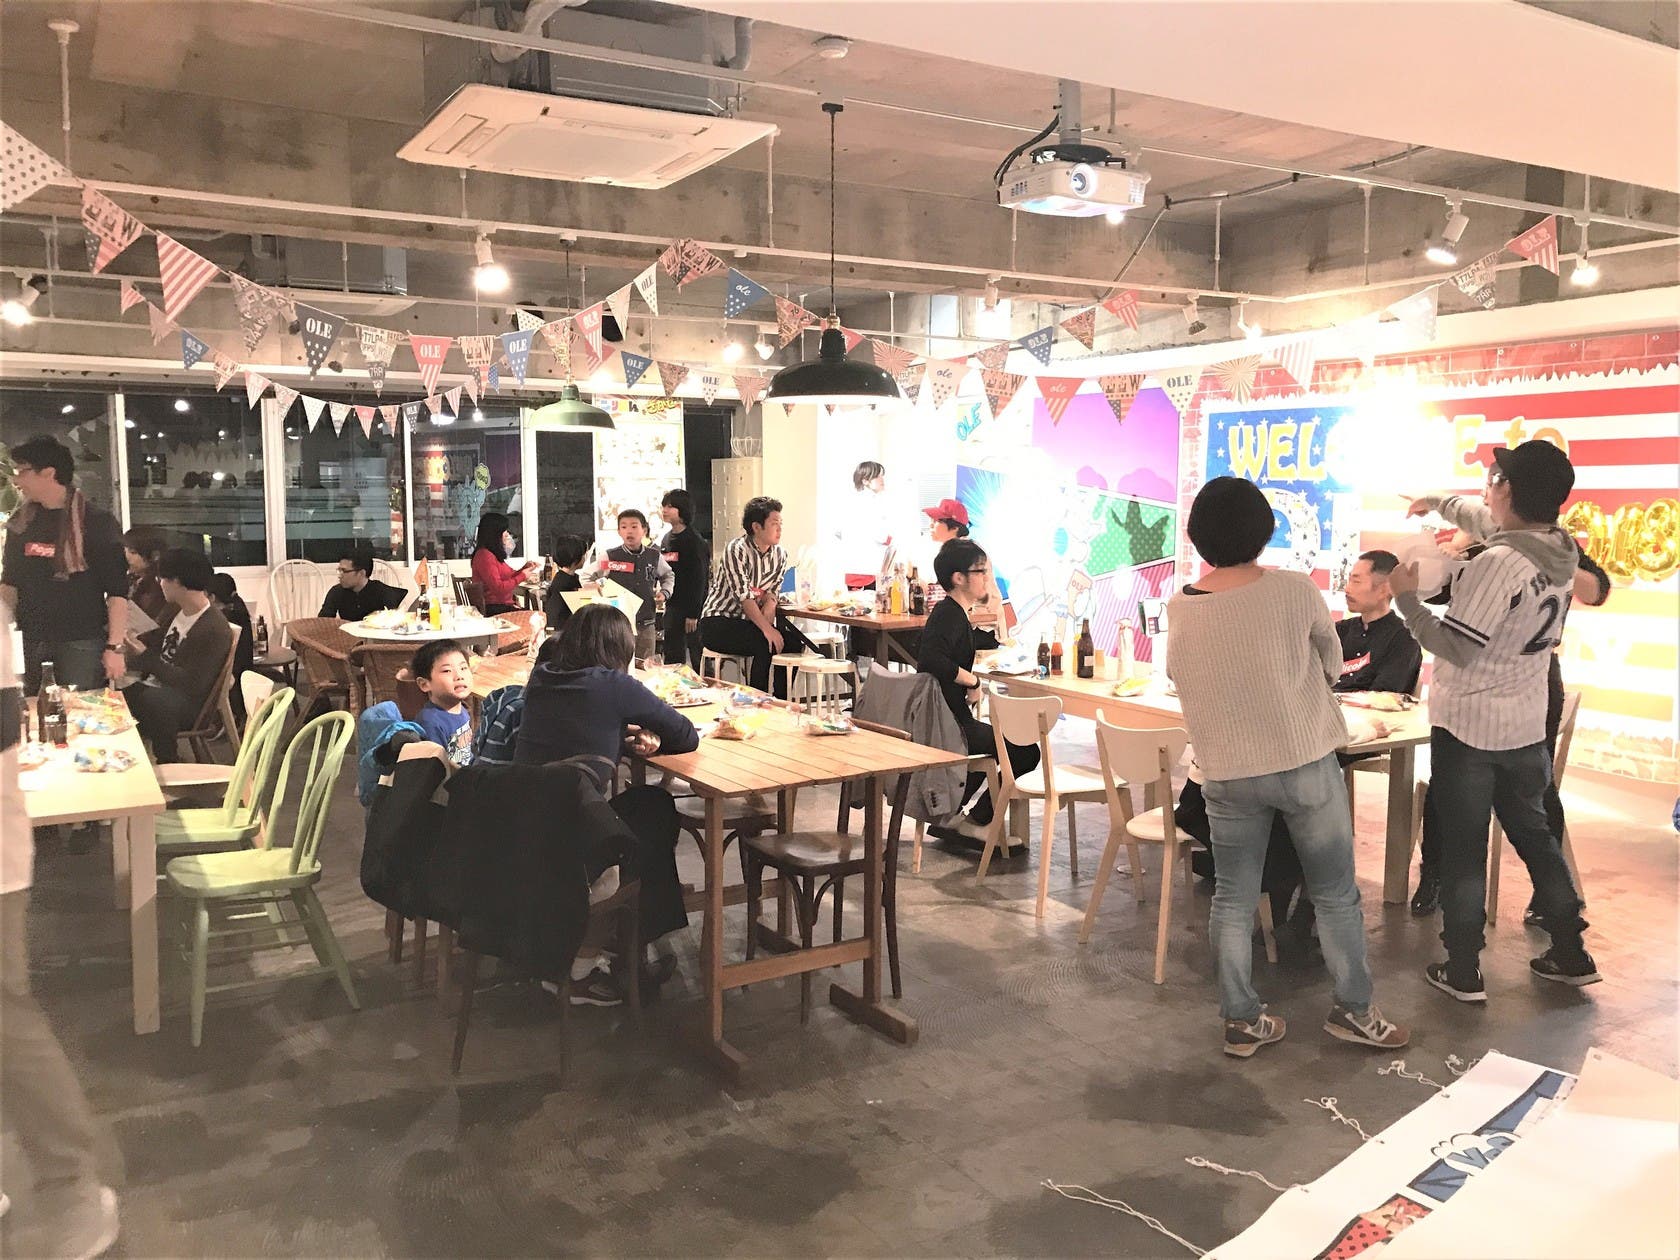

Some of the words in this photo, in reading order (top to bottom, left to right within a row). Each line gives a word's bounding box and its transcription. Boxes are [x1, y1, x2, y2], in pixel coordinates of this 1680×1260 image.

[1521, 227, 1551, 252] OLE
[641, 273, 654, 291] OLE
[735, 284, 751, 296] ole
[305, 317, 333, 340] OLE
[420, 343, 441, 359] OLE
[509, 338, 528, 354] OLE
[626, 357, 645, 370] OLE
[702, 375, 720, 386] OLE
[936, 367, 953, 379] ole
[1049, 382, 1069, 394] ole
[1166, 374, 1193, 389] OLE
[955, 401, 982, 441] OLE
[1228, 415, 1485, 482] WELE
